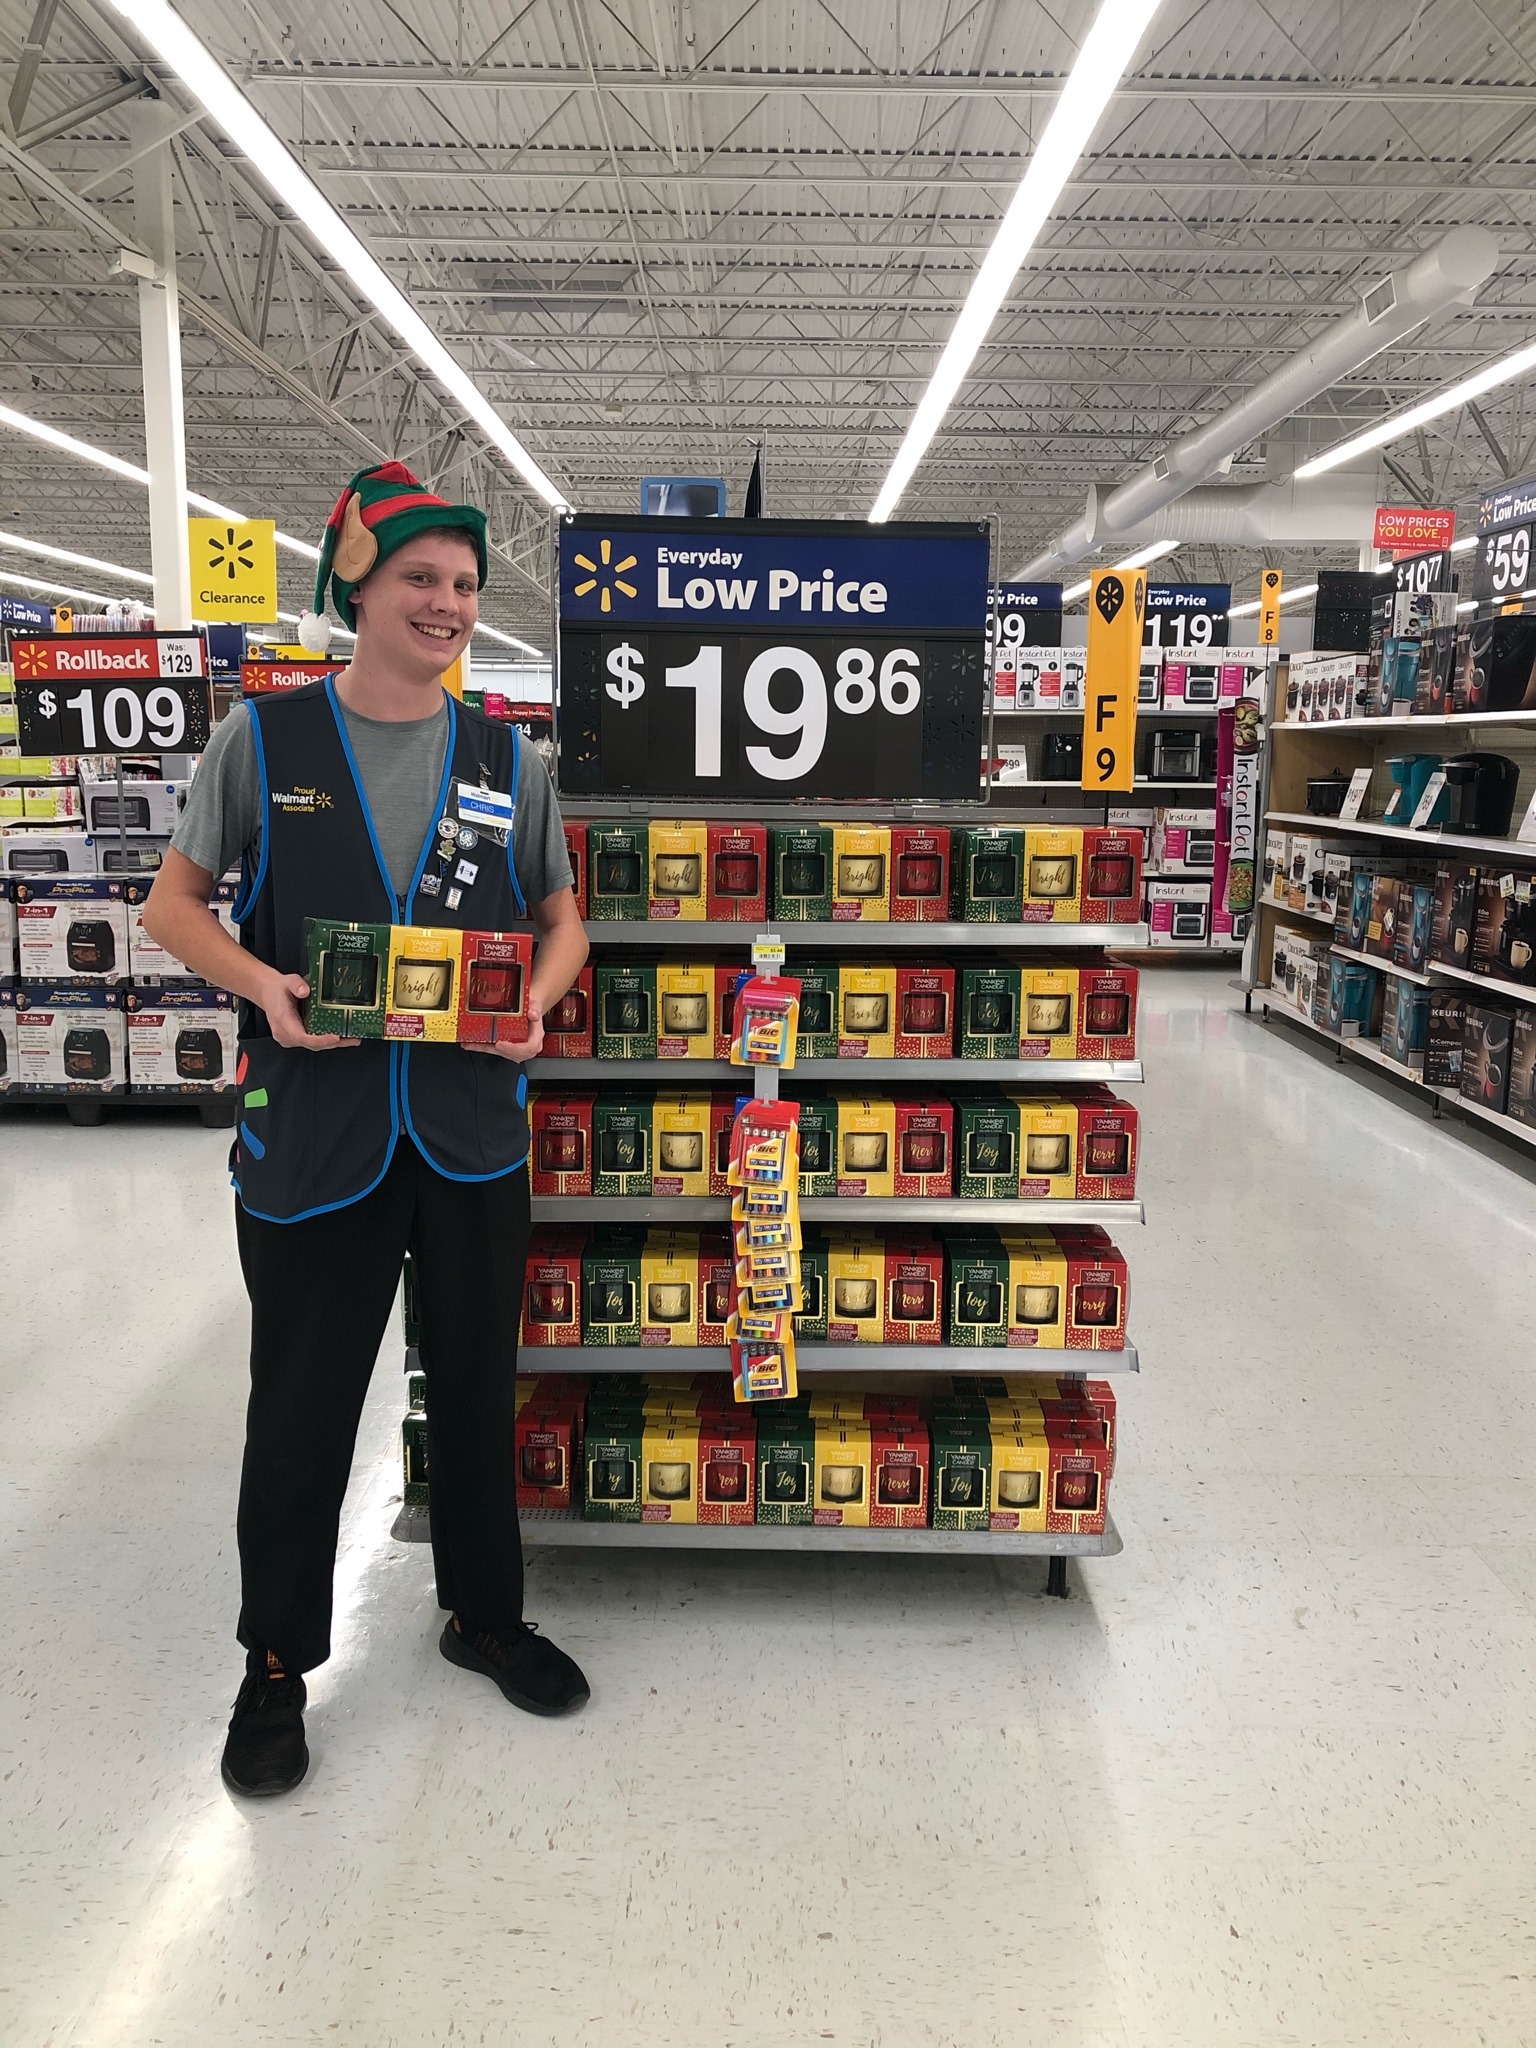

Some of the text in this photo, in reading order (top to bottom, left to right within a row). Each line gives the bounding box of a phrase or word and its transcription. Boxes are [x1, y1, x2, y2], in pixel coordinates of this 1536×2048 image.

[1493, 496, 1536, 523] Low Price
[1379, 516, 1449, 528] LOW PRICES
[1378, 526, 1441, 539] YOU LOVE.
[657, 547, 743, 569] Everyday
[657, 566, 888, 613] Low Price
[200, 591, 265, 605] Clearance
[1007, 593, 1039, 605] Price
[1147, 594, 1207, 607] Low Price
[13, 607, 42, 623] Low Price
[1265, 611, 1274, 624] F
[1265, 629, 1273, 641] 8
[166, 642, 187, 652] Was:
[1168, 649, 1198, 658] Instant
[55, 650, 150, 671] Rollback
[1019, 650, 1043, 658] Instant
[1226, 650, 1254, 658] Instant
[272, 671, 331, 686] Rollbac
[512, 709, 529, 717] Happy
[529, 710, 551, 718] Holidays.
[1096, 695, 1117, 733] F
[1096, 748, 1116, 782] 9
[293, 786, 316, 796] Proud
[470, 791, 491, 801] Walmart
[272, 792, 315, 805] Walmart
[282, 803, 315, 813] Associate
[470, 801, 495, 814] CHRIS
[1233, 758, 1254, 853] Instant Pot
[1109, 810, 1130, 819] stant
[1169, 812, 1198, 822] Instant
[1155, 886, 1185, 895] Instant
[399, 973, 441, 1001] Bright
[1432, 1008, 1466, 1018] KEURI
